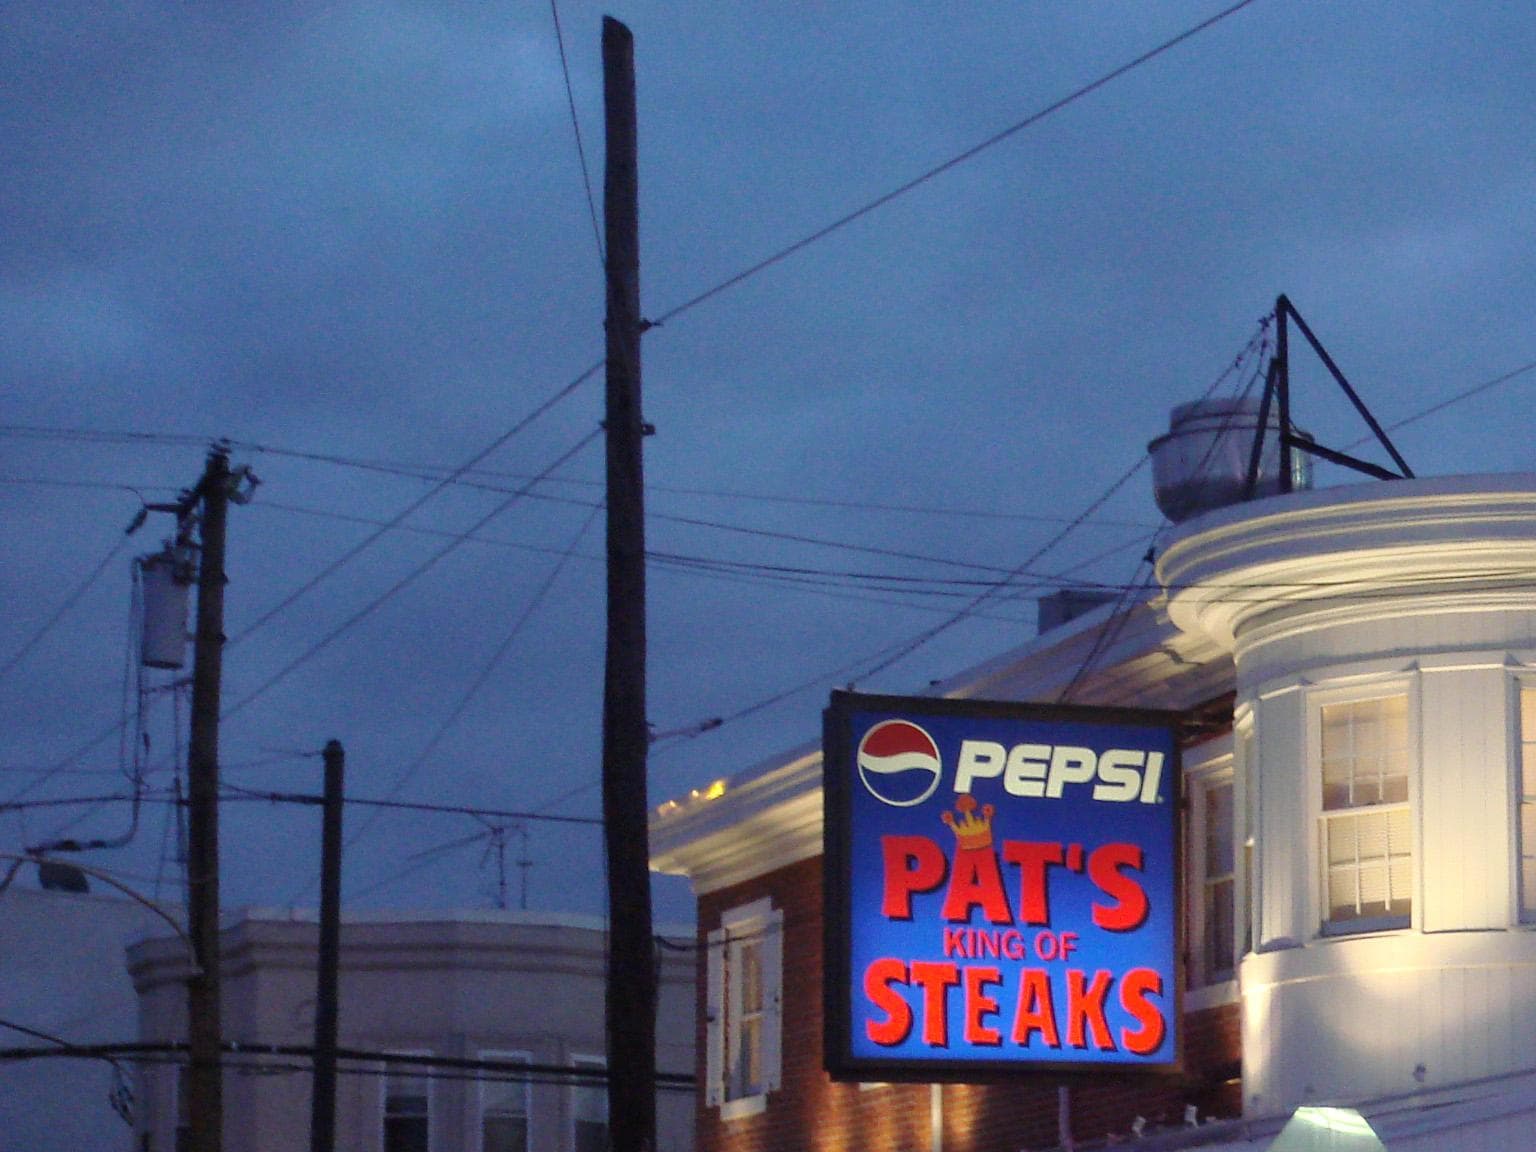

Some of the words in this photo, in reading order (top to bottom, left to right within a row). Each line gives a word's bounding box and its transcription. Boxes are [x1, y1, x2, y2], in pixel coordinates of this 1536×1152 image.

[953, 740, 1165, 805] PEPSI
[880, 834, 1150, 931] PAT'S
[943, 927, 1025, 960] KING
[1033, 931, 1080, 961] OF
[863, 957, 1166, 1056] STEAKS
